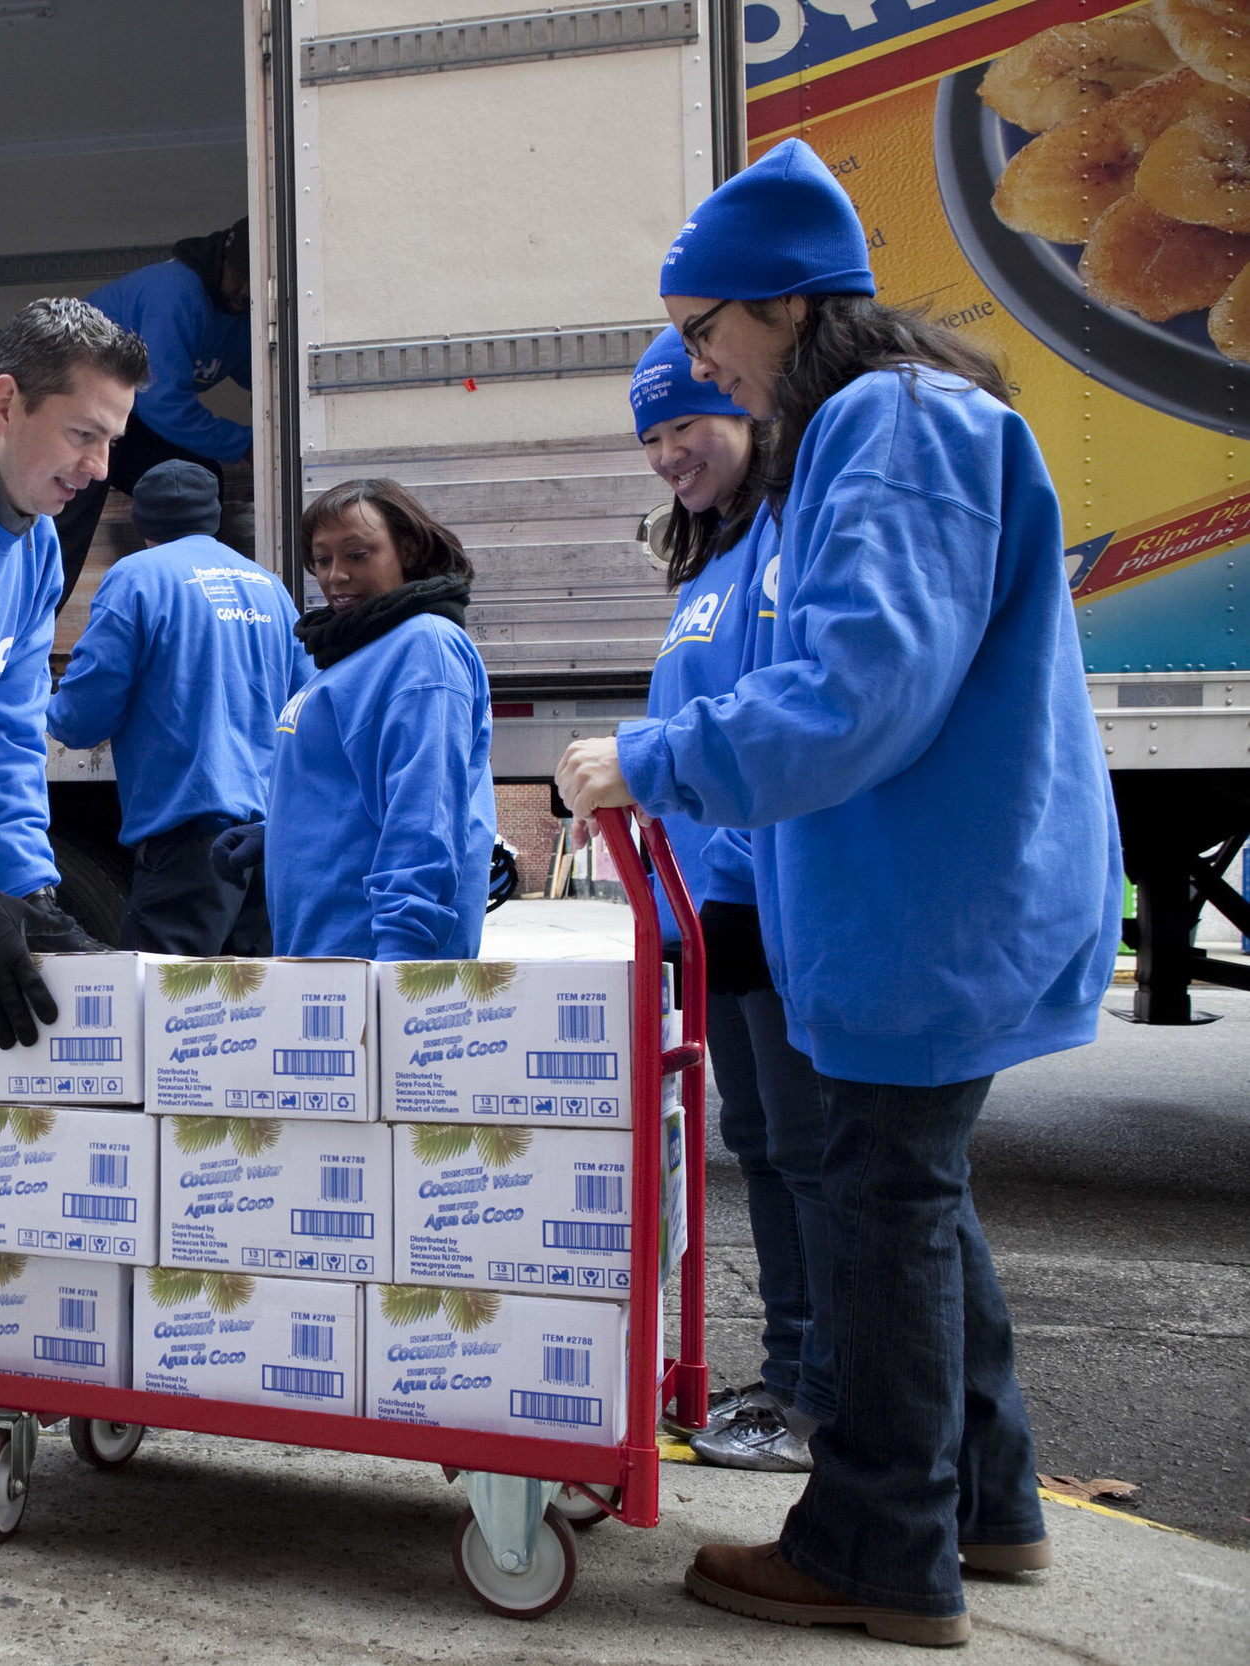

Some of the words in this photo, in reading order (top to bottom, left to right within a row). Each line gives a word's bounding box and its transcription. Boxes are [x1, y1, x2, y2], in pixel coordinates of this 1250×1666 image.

[1113, 522, 1238, 578] Plátanos
[1128, 523, 1199, 557] Ripe
[165, 1008, 226, 1034] Coconut
[230, 1006, 266, 1022] Water
[404, 1008, 473, 1036] Coconut
[477, 1006, 517, 1023] Water
[169, 1047, 200, 1063] Agua
[202, 1042, 218, 1056] de
[221, 1038, 257, 1054] Coco
[409, 1050, 443, 1067] Agua
[446, 1045, 464, 1060] de
[467, 1040, 508, 1057] Coco
[434, 1073, 442, 1081] by
[342, 1156, 366, 1164] #2788
[574, 1163, 596, 1171] ITEM
[598, 1164, 625, 1172] #2788
[179, 1165, 243, 1189] Coconut
[247, 1165, 283, 1180] Water
[418, 1174, 489, 1199] Coconut
[493, 1174, 533, 1189] Water
[184, 1203, 215, 1219] Agua
[218, 1199, 234, 1213] de
[237, 1197, 275, 1212] Coco
[172, 1223, 206, 1231] Distributed
[424, 1214, 458, 1231] Agua
[462, 1210, 480, 1225] de
[482, 1207, 524, 1224] Coco
[410, 1235, 448, 1244] Distributed
[449, 1238, 458, 1246] by
[410, 1244, 427, 1252] Goya
[429, 1245, 447, 1253] Food,
[172, 1247, 218, 1255] www.goya.com
[411, 1262, 461, 1270] www.goya.com
[446, 1271, 475, 1279] Vietnam
[291, 1312, 310, 1320] ITEM
[312, 1314, 336, 1323] #2788
[154, 1318, 216, 1339] Coconut
[219, 1320, 255, 1333] Water
[542, 1334, 564, 1343] ITEM
[567, 1336, 593, 1346] #2788
[158, 1353, 188, 1370] Agua
[191, 1351, 207, 1365] de
[209, 1350, 246, 1365] Coco
[387, 1340, 457, 1362] Coconut
[461, 1343, 502, 1356] Water
[393, 1377, 427, 1395] Agua
[430, 1376, 448, 1390] de
[451, 1374, 492, 1390] Coco
[379, 1398, 416, 1408] Distributed
[417, 1403, 426, 1411] by
[379, 1406, 396, 1415] Goya
[397, 1409, 415, 1417] Food,
